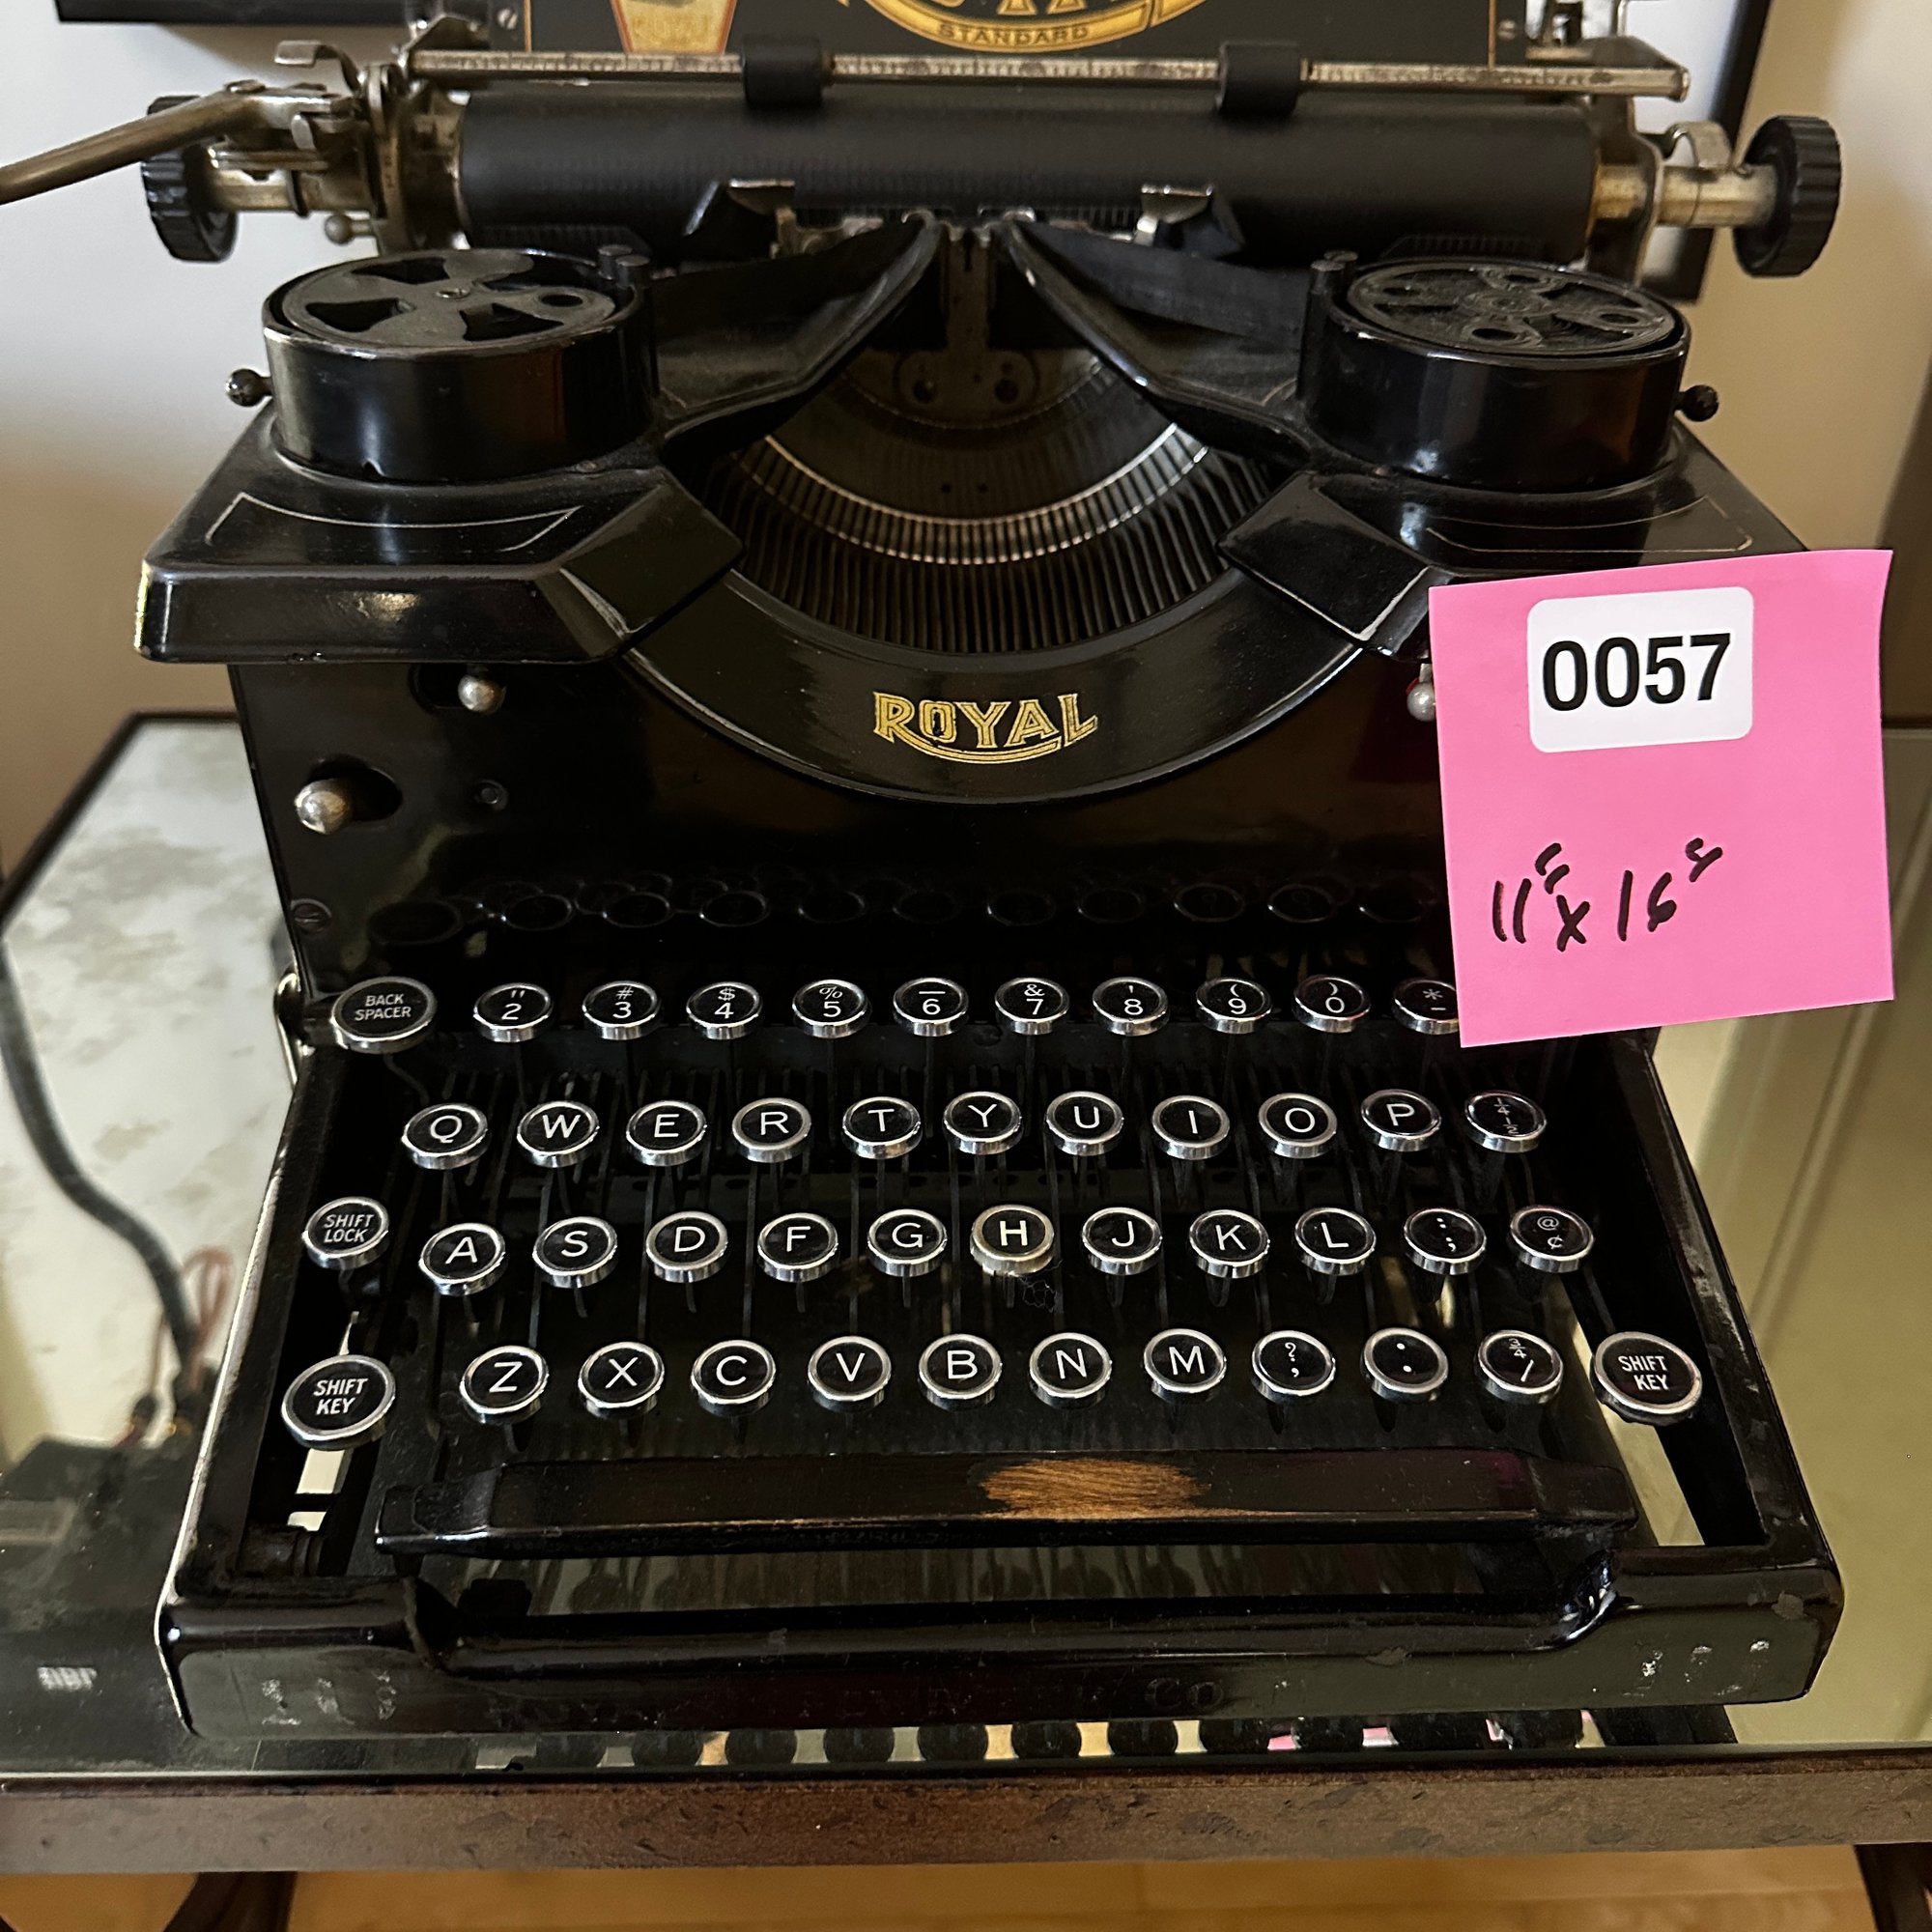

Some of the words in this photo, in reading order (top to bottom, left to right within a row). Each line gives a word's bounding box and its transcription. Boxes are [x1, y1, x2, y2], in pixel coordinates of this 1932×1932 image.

[937, 22, 1089, 45] STANDARD
[1544, 633, 1730, 711] 0057
[873, 692, 1098, 764] ROYAL
[365, 994, 403, 1007] BACK
[719, 986, 736, 1001] $
[1024, 982, 1047, 996] &
[355, 1006, 411, 1020] SPACER
[501, 1004, 521, 1020] 2
[613, 1002, 631, 1018] 3
[715, 1003, 733, 1018] 4
[824, 1002, 840, 1017] 5
[923, 999, 940, 1014] 6
[1027, 999, 1043, 1014] 7
[1124, 999, 1143, 1015] 8
[1229, 998, 1246, 1014] 9
[654, 1114, 679, 1137] E
[761, 1112, 788, 1135] R
[868, 1109, 895, 1131] T
[968, 1104, 997, 1127] Y
[1074, 1106, 1099, 1128] U
[1189, 1111, 1198, 1133] I
[1285, 1108, 1315, 1132] O
[1387, 1104, 1414, 1125] P
[430, 1116, 462, 1143] Q
[543, 1115, 581, 1138] W
[323, 1212, 374, 1228] SHIFT
[325, 1229, 369, 1244] LOCK
[561, 1231, 587, 1257] S
[674, 1227, 705, 1252] D
[787, 1226, 810, 1252] F
[893, 1223, 923, 1247] G
[1000, 1221, 1027, 1245] H
[1112, 1221, 1134, 1246] J
[1216, 1225, 1246, 1250] K
[1321, 1223, 1349, 1247] L
[444, 1236, 477, 1264] A
[717, 1356, 747, 1385] C
[837, 1353, 865, 1381] V
[948, 1350, 978, 1379] B
[1056, 1349, 1087, 1378] N
[1169, 1346, 1205, 1375] M
[1618, 1356, 1666, 1372] SHIFT
[490, 1361, 522, 1392] Z
[606, 1357, 638, 1388] X
[1634, 1375, 1668, 1390] KEY
[314, 1378, 368, 1396] SHIFT
[317, 1398, 355, 1414] KEY
